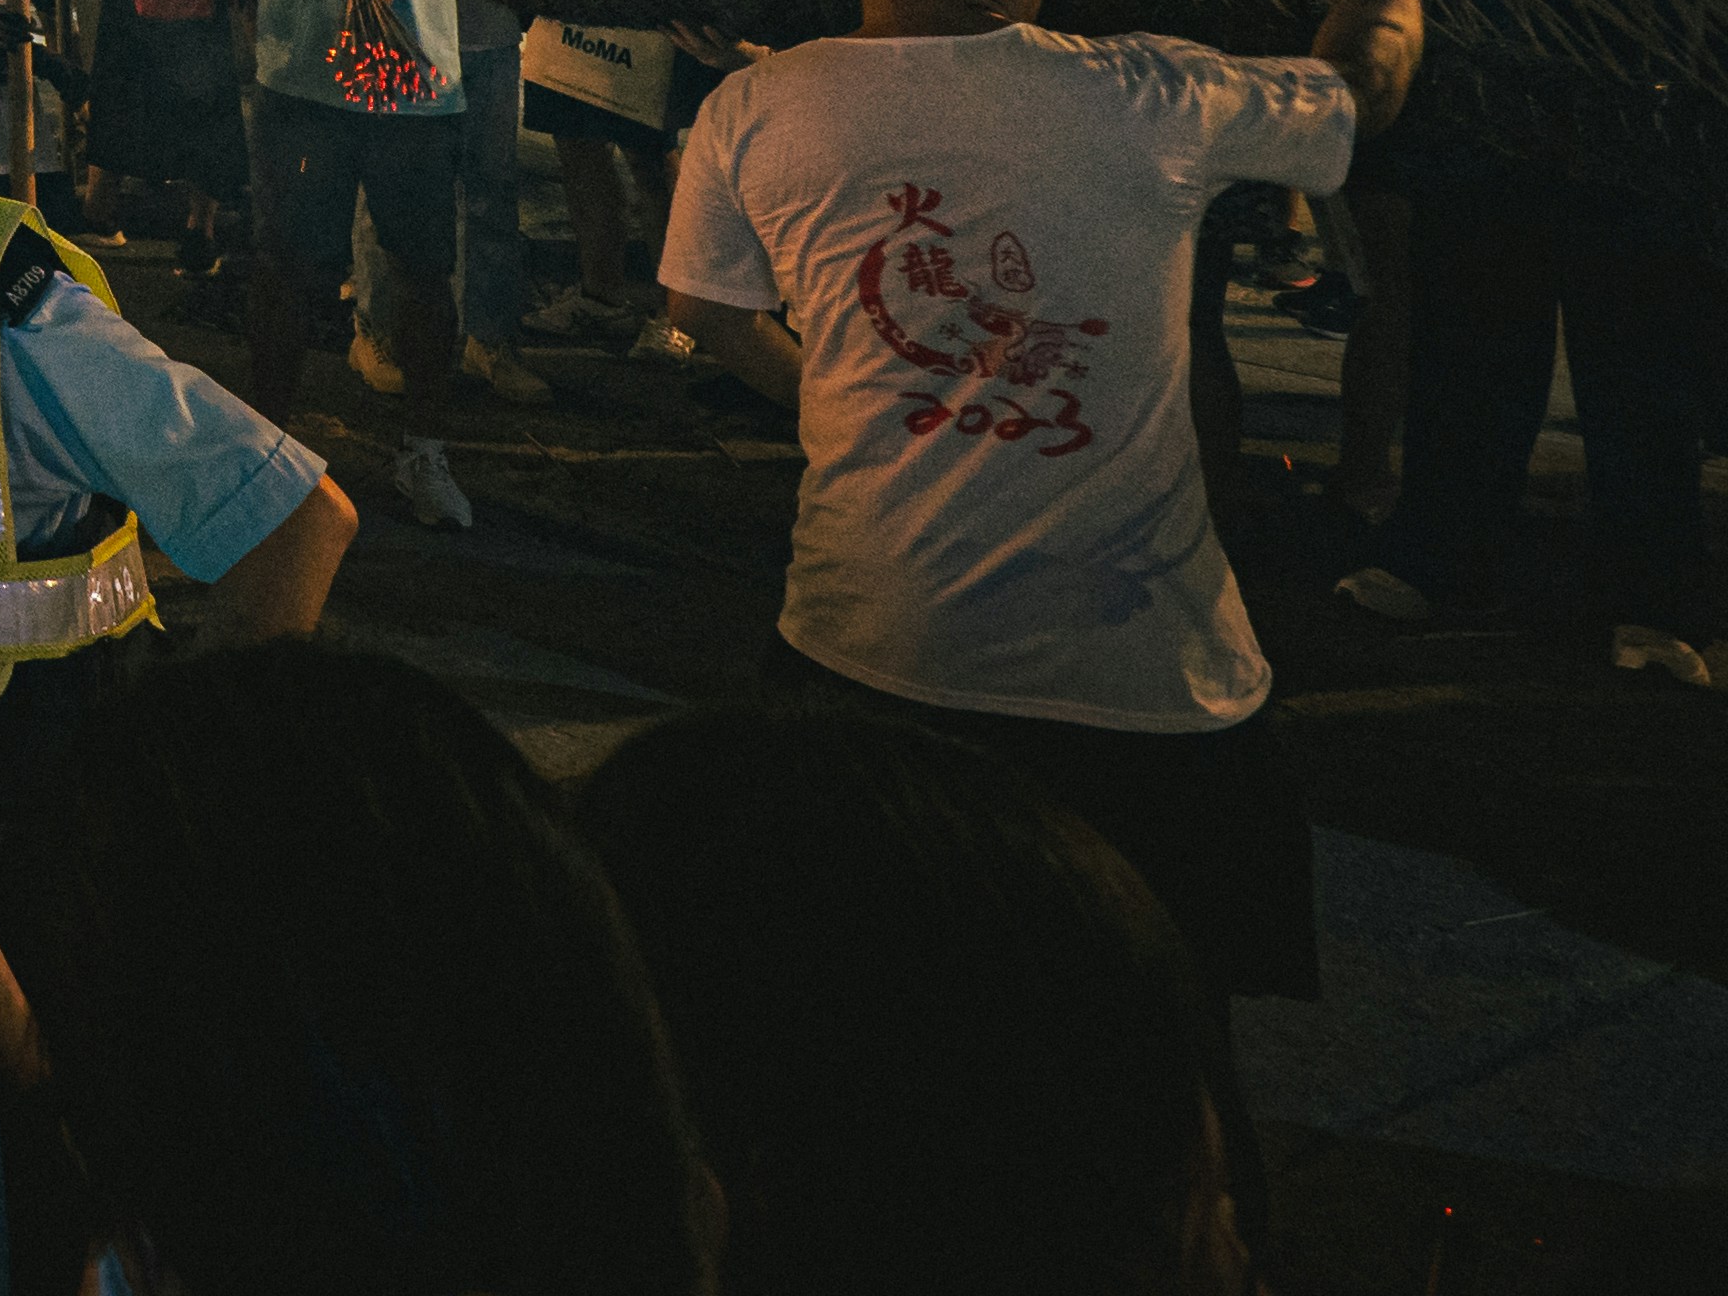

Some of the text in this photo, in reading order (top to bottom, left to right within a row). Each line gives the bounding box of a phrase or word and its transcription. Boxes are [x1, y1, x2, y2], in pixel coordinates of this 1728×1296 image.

[561, 26, 633, 70] MoMA
[885, 182, 969, 299] 火龍
[5, 265, 46, 307] A8709
[897, 388, 1094, 458] 2023
